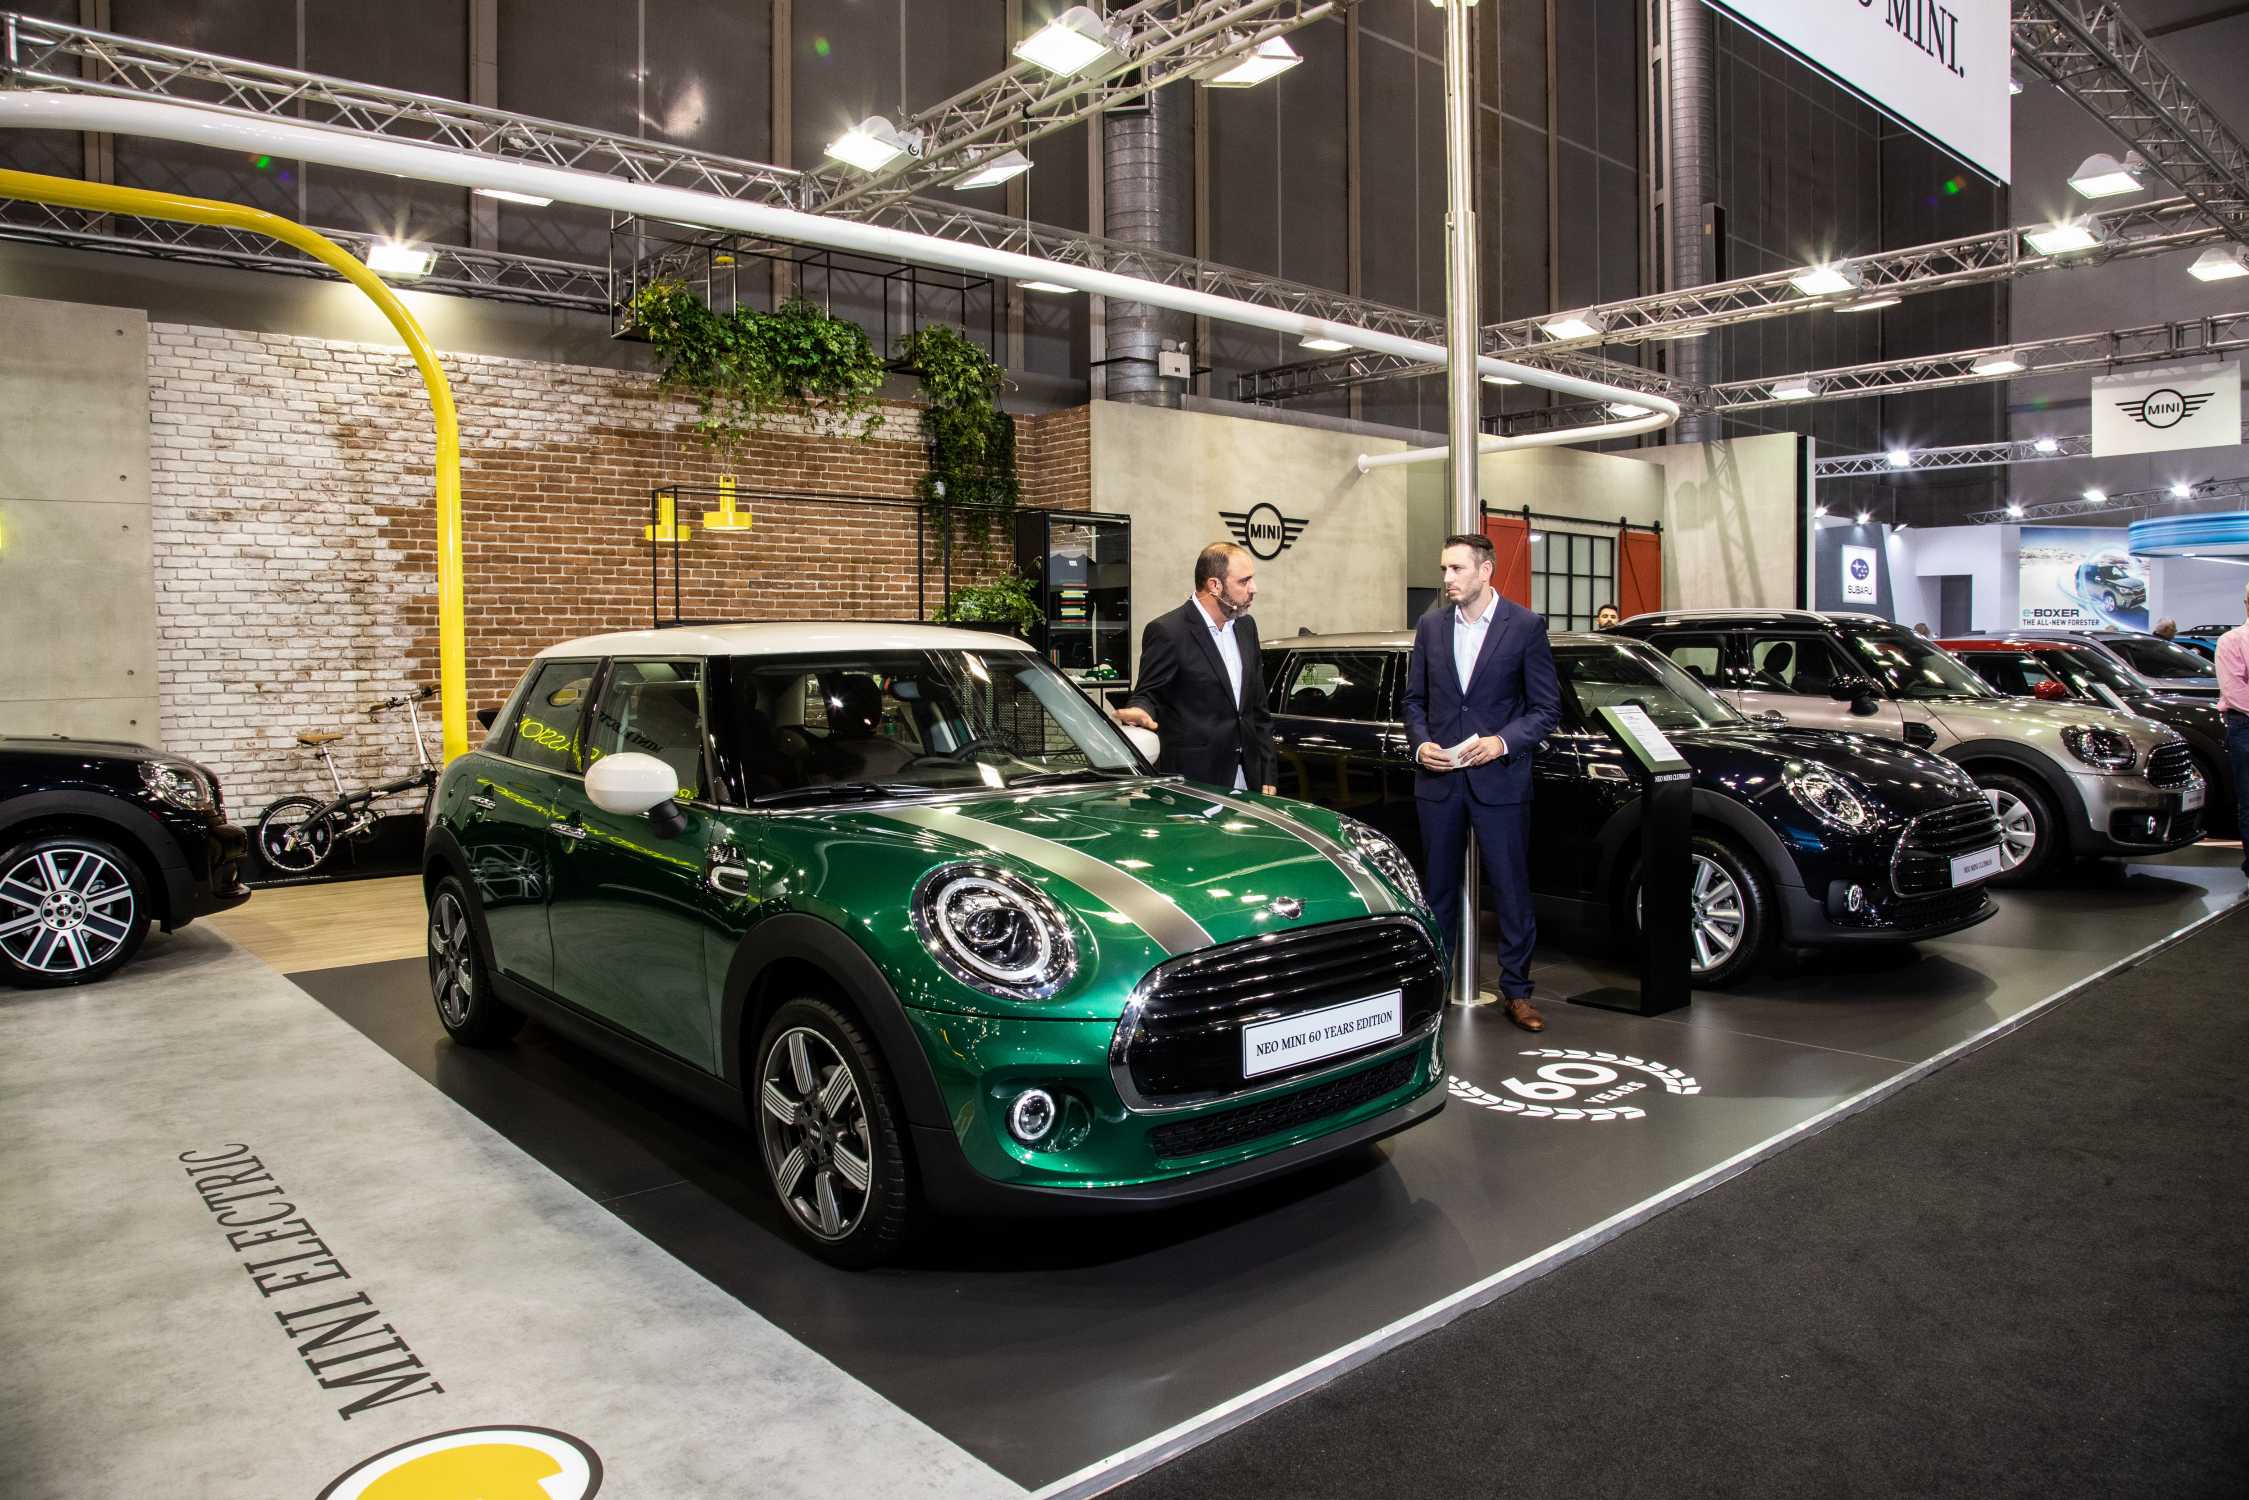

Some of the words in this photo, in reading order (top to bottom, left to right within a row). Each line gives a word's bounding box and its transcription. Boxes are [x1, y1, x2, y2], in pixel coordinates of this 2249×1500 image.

[1885, 0, 1964, 78] MINI.
[2148, 402, 2180, 415] MINI
[1250, 524, 1280, 540] MINI
[2023, 608, 2080, 617] e-BOXER
[1256, 1040, 1279, 1056] NEO
[1281, 1034, 1306, 1050] MINI
[1308, 1030, 1321, 1043] 60
[1324, 1022, 1354, 1039] YEARS
[1356, 1010, 1393, 1030] EDITION
[1501, 1062, 1618, 1100] 60
[1584, 1081, 1648, 1104] YEARS
[179, 1143, 352, 1298] ELECTRIC
[274, 1291, 446, 1420] MINI
